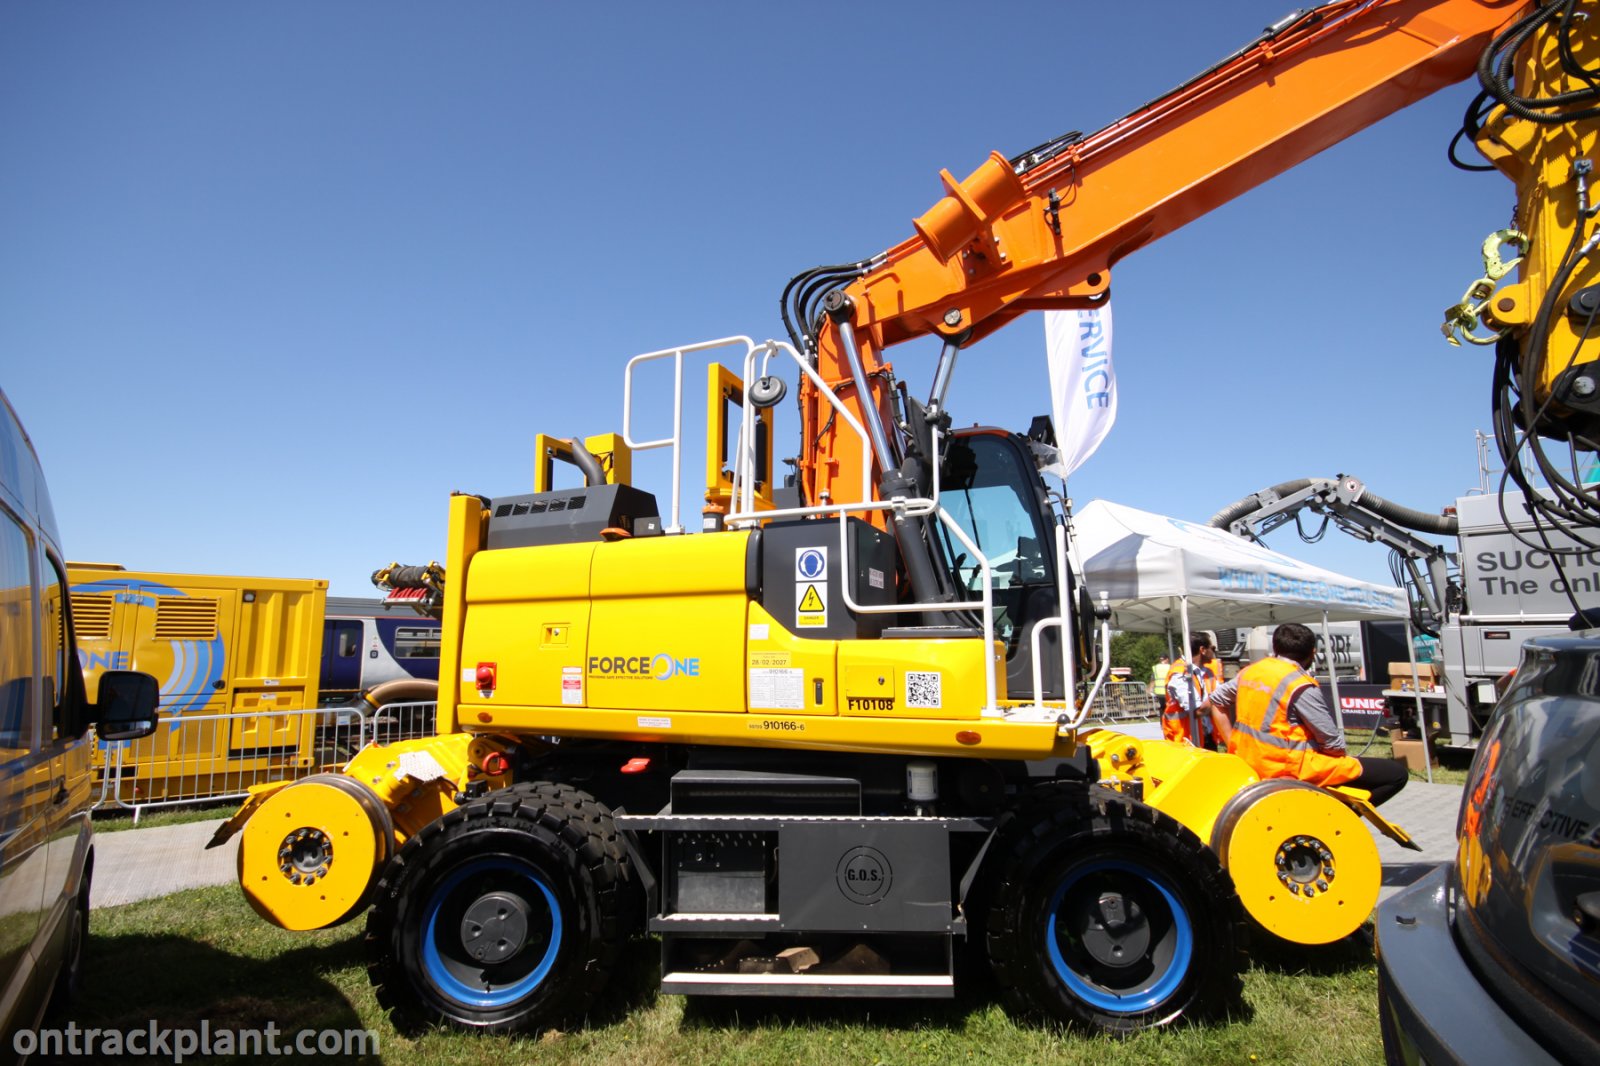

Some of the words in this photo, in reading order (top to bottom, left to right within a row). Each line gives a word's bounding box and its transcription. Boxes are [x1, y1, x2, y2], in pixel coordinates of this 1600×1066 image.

[1479, 577, 1538, 595] The
[848, 699, 894, 711] F10108
[1341, 698, 1386, 710] UNIC
[1511, 799, 1590, 840] EFFCTIVE
[847, 868, 882, 882] G.O.S.
